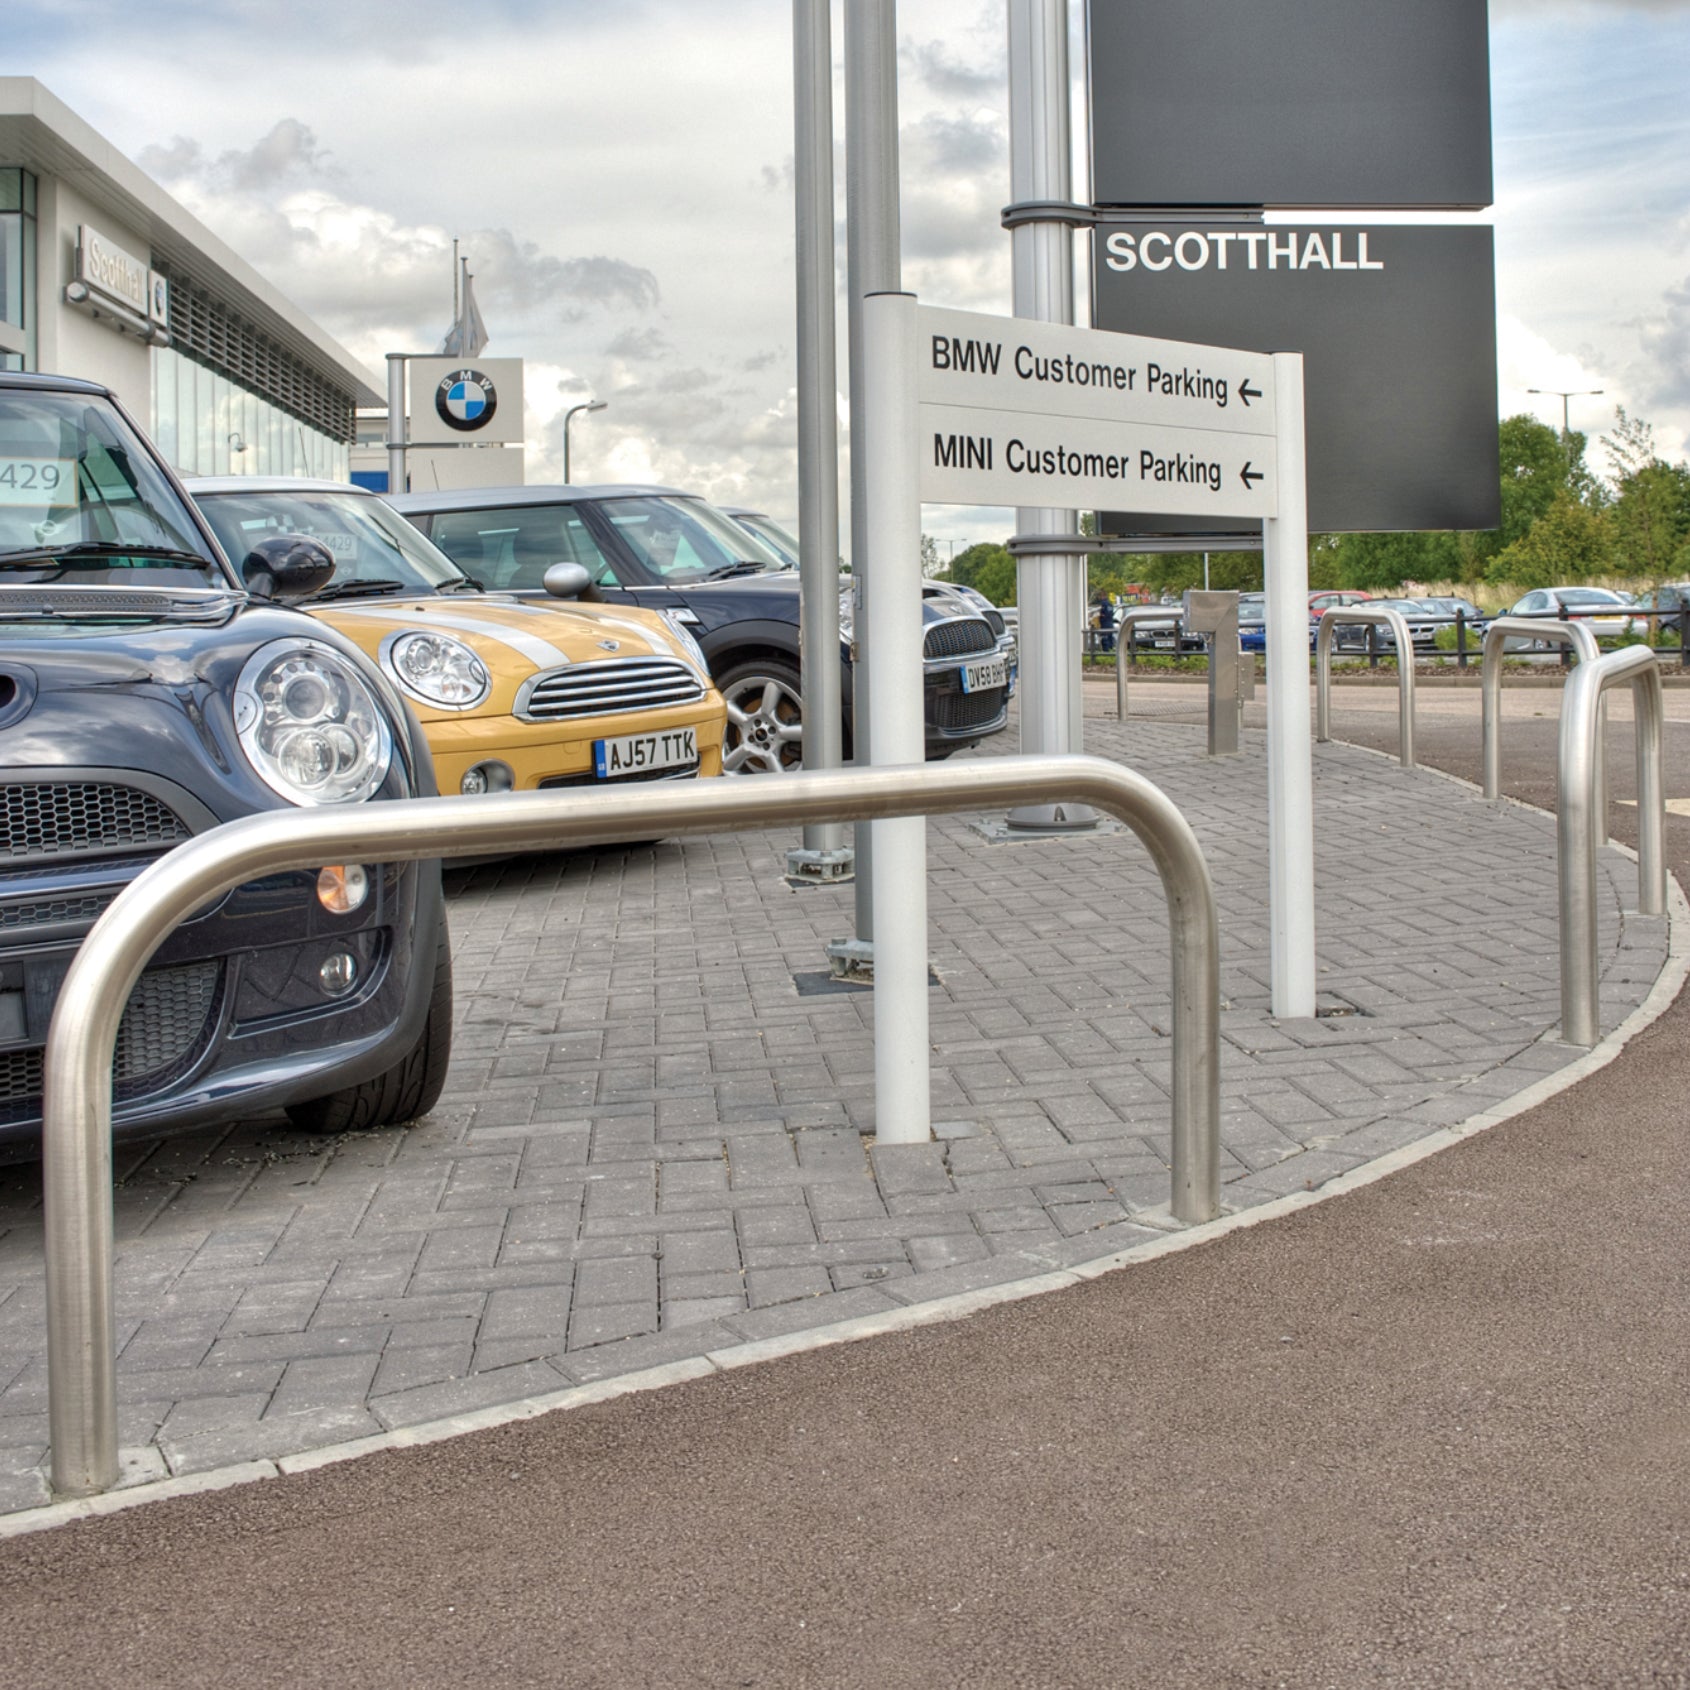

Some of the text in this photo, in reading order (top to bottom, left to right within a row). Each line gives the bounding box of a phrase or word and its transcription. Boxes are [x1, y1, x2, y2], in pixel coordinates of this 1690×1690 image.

[1105, 231, 1384, 271] SCOTTHALL
[441, 370, 492, 391] BMW
[932, 335, 1228, 408] BMW Customer Parking
[0, 463, 60, 490] 429
[934, 433, 1221, 492] MINI Customer Parking
[611, 731, 694, 770] AJ57 TTK
